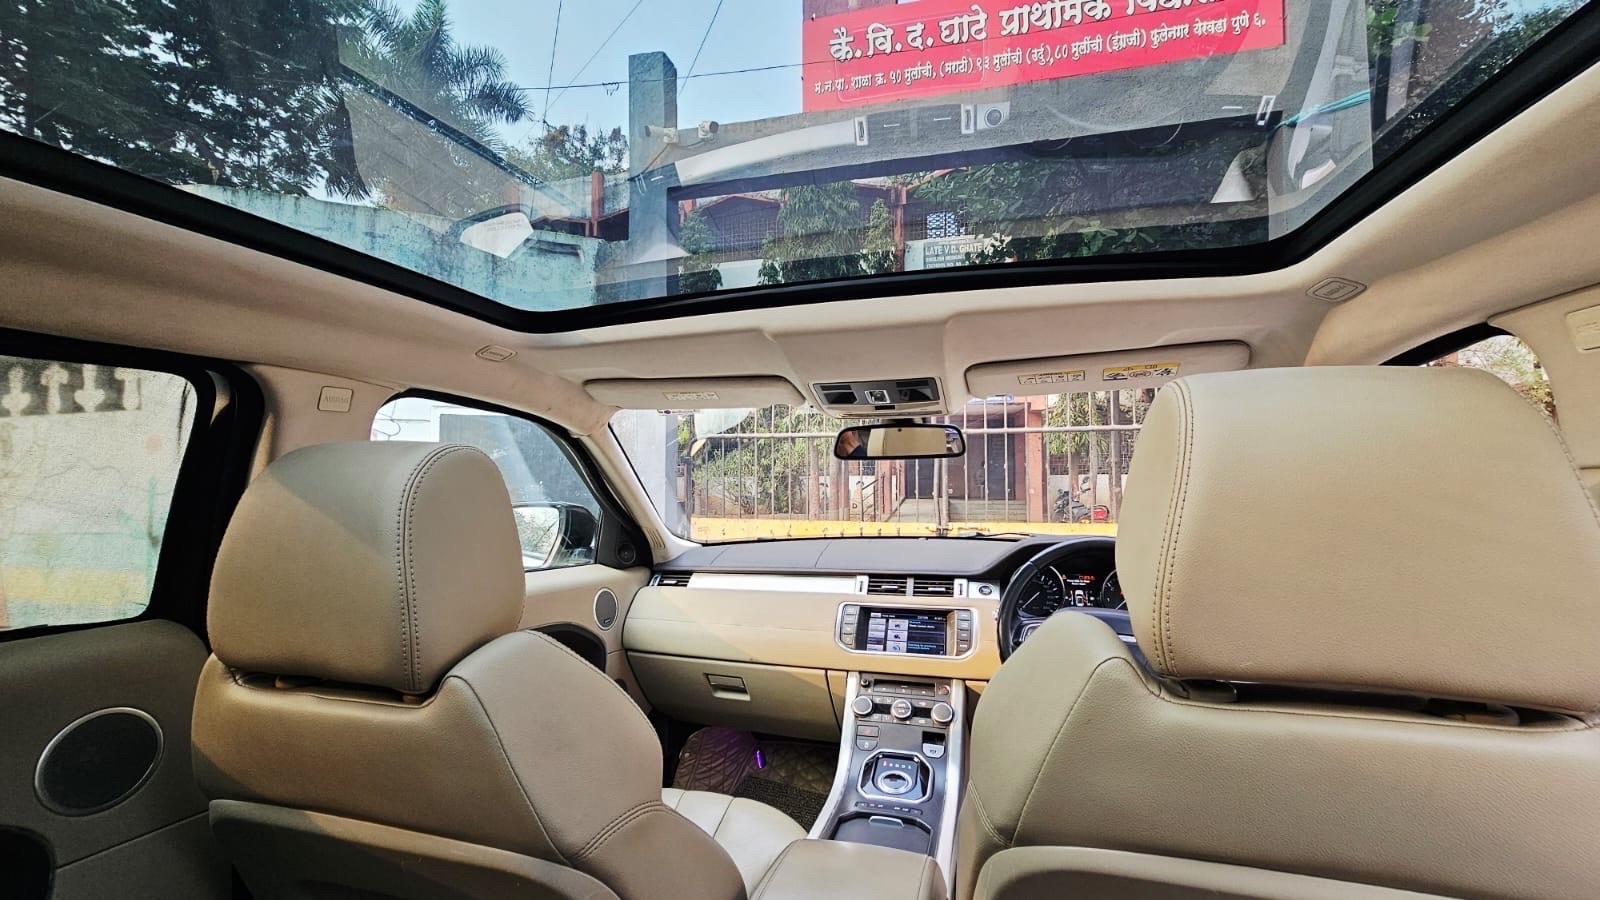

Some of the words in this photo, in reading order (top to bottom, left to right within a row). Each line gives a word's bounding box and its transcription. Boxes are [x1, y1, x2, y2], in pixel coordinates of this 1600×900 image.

[851, 73, 871, 90] शाळा
[939, 55, 973, 77] (मराठी)
[992, 47, 1023, 72] मुलांची
[1150, 22, 1190, 49] फुलेनगर
[1193, 18, 1228, 37] येरवडा
[1231, 9, 1250, 35] पुणे
[925, 246, 943, 256] LATE
[960, 242, 983, 253] GHATE
